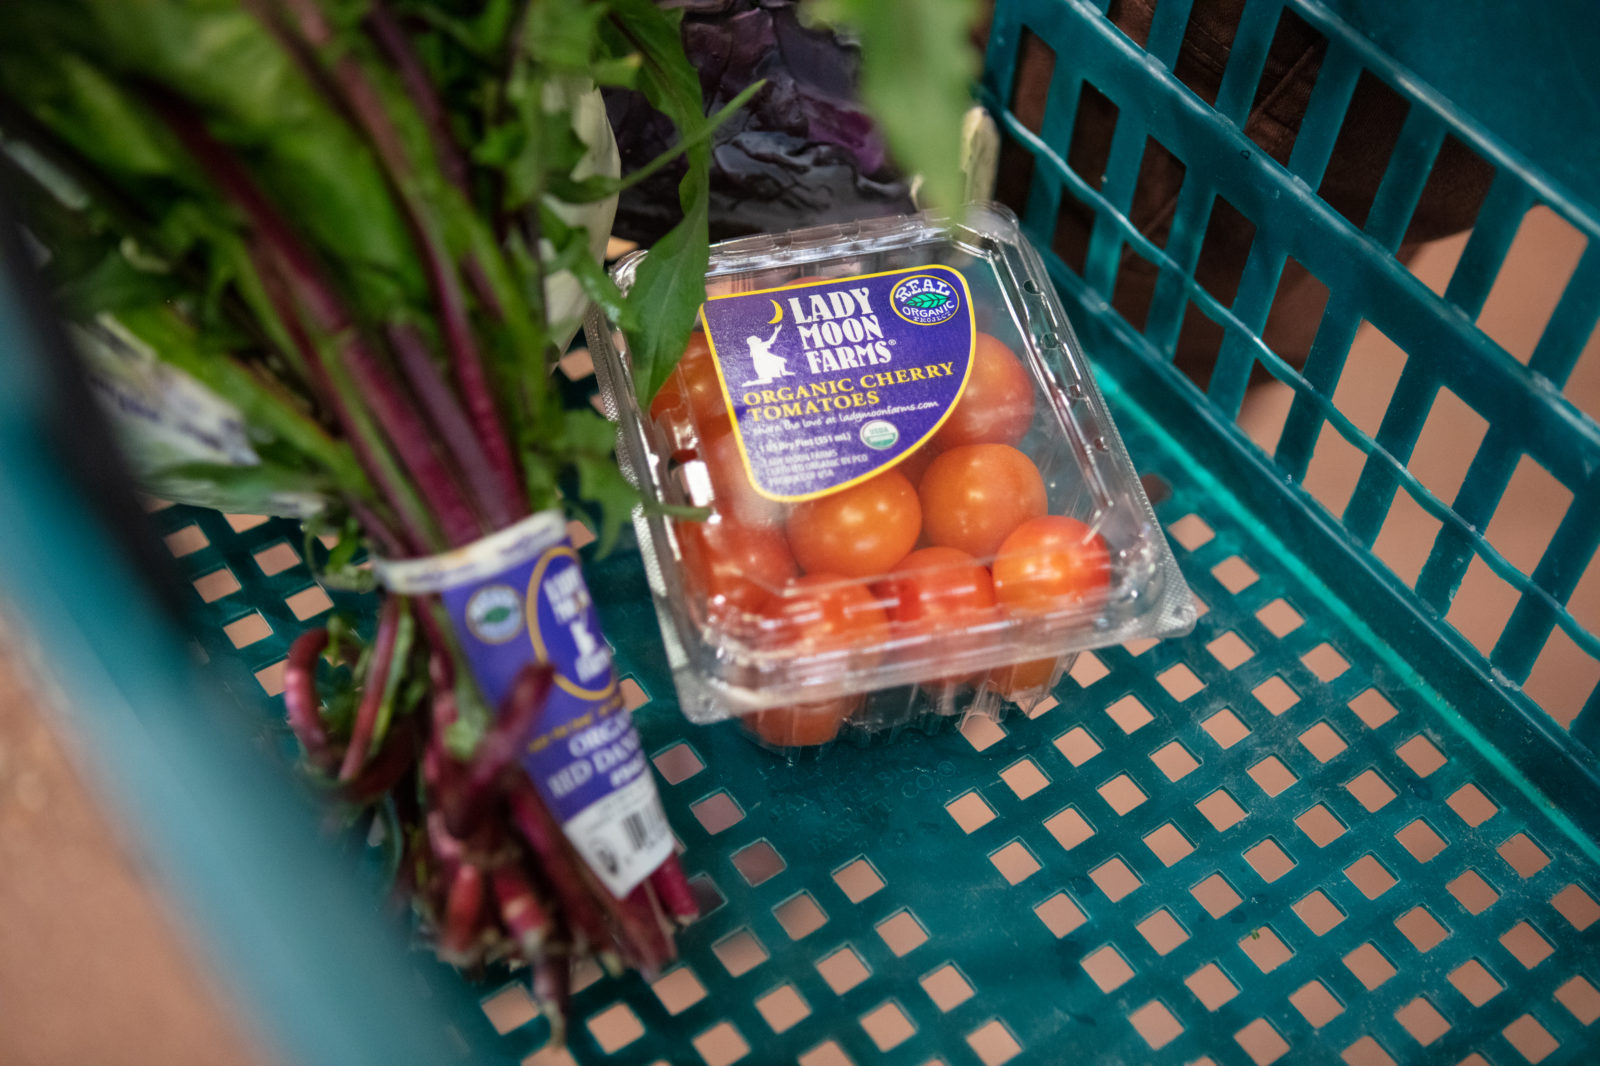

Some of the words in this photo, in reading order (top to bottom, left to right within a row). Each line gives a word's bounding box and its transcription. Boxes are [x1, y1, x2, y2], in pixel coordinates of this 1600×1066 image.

[788, 287, 873, 324] LADY
[894, 278, 951, 302] REAL
[901, 300, 955, 318] ORGANIC
[797, 315, 884, 350] MOON
[743, 378, 854, 406] ORGANIC
[860, 361, 954, 388] CHERRY
[746, 390, 880, 422] TOMATOES
[825, 416, 837, 426] at
[838, 401, 940, 423] ladymoonfarms.com
